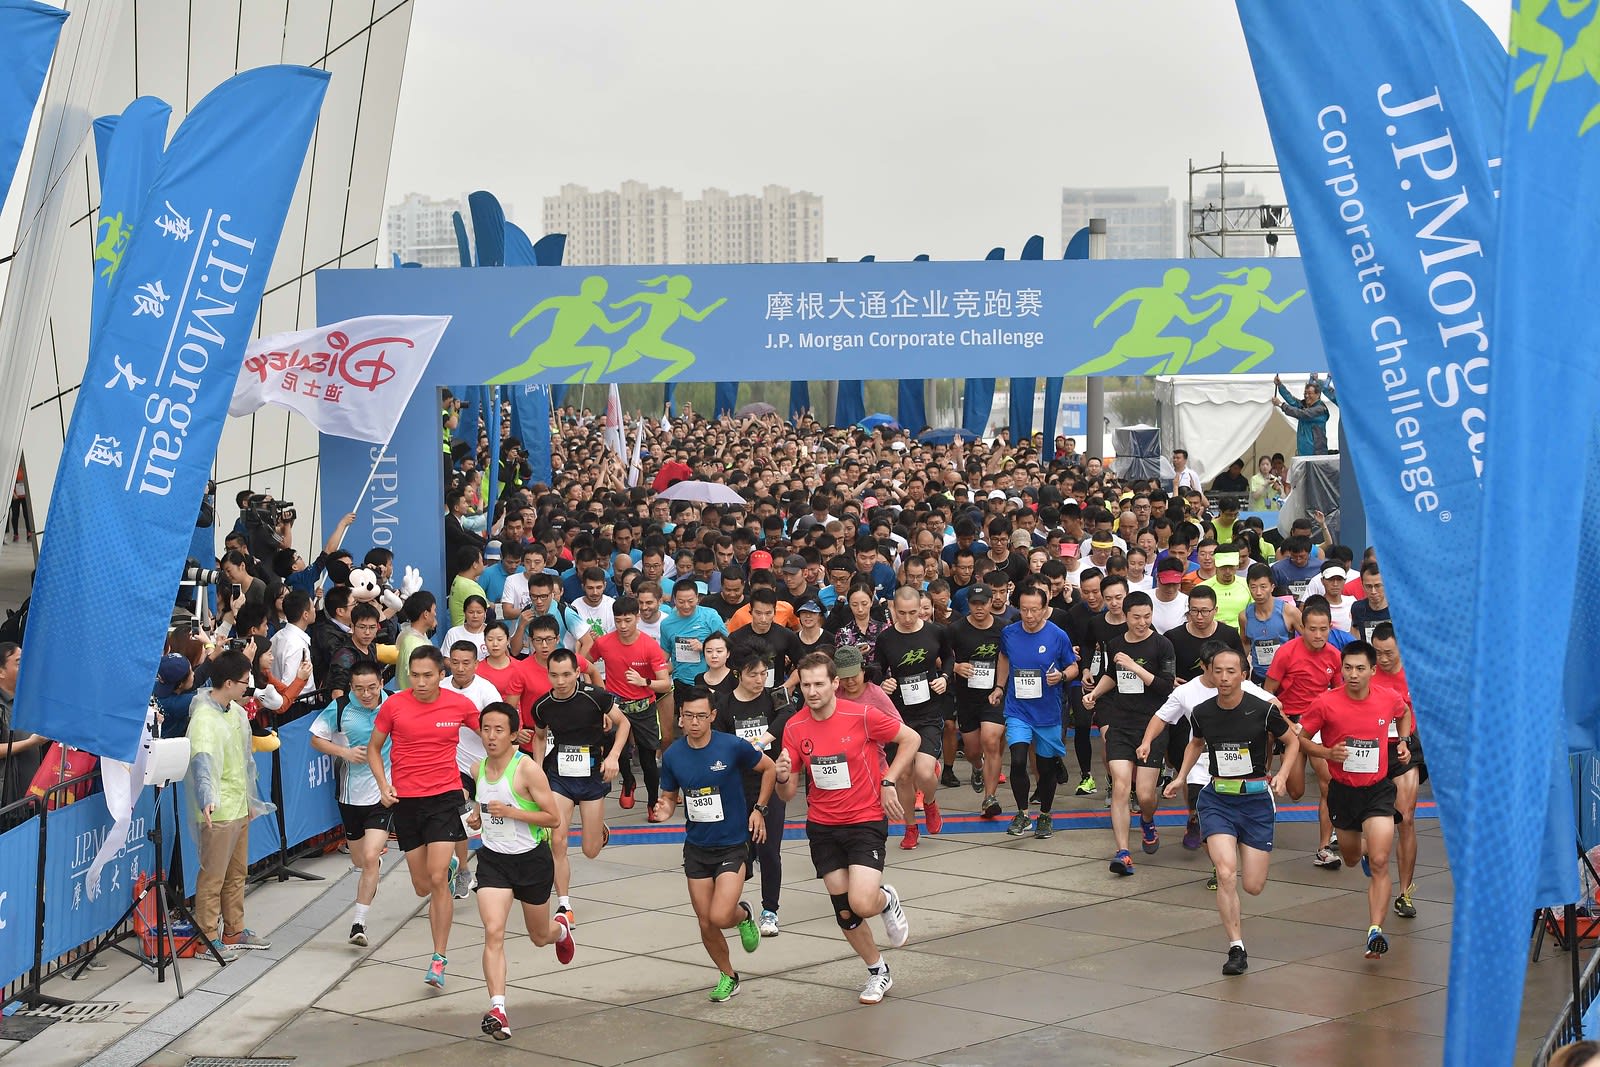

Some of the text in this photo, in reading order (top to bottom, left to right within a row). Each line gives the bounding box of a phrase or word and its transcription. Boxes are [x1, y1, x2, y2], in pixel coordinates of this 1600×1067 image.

[1317, 105, 1387, 304] Corporate
[1377, 83, 1490, 490] J.P.Morga
[765, 288, 1044, 320] 摩根大通企业竞跑赛
[84, 200, 194, 468] 摩根大通
[765, 329, 1044, 350] J.P. Morgan Corporate Challenge
[139, 213, 257, 496] J.P.Morgan
[370, 446, 399, 552] J.P.Mo
[1020, 678, 1036, 686] 1165
[911, 684, 919, 692] 30
[744, 728, 762, 738] 2311
[565, 754, 583, 763] 2070
[1224, 752, 1242, 761] 3694
[1355, 750, 1370, 758] 417
[822, 765, 838, 775] 326
[693, 797, 713, 808] 3830
[490, 815, 504, 825] 353
